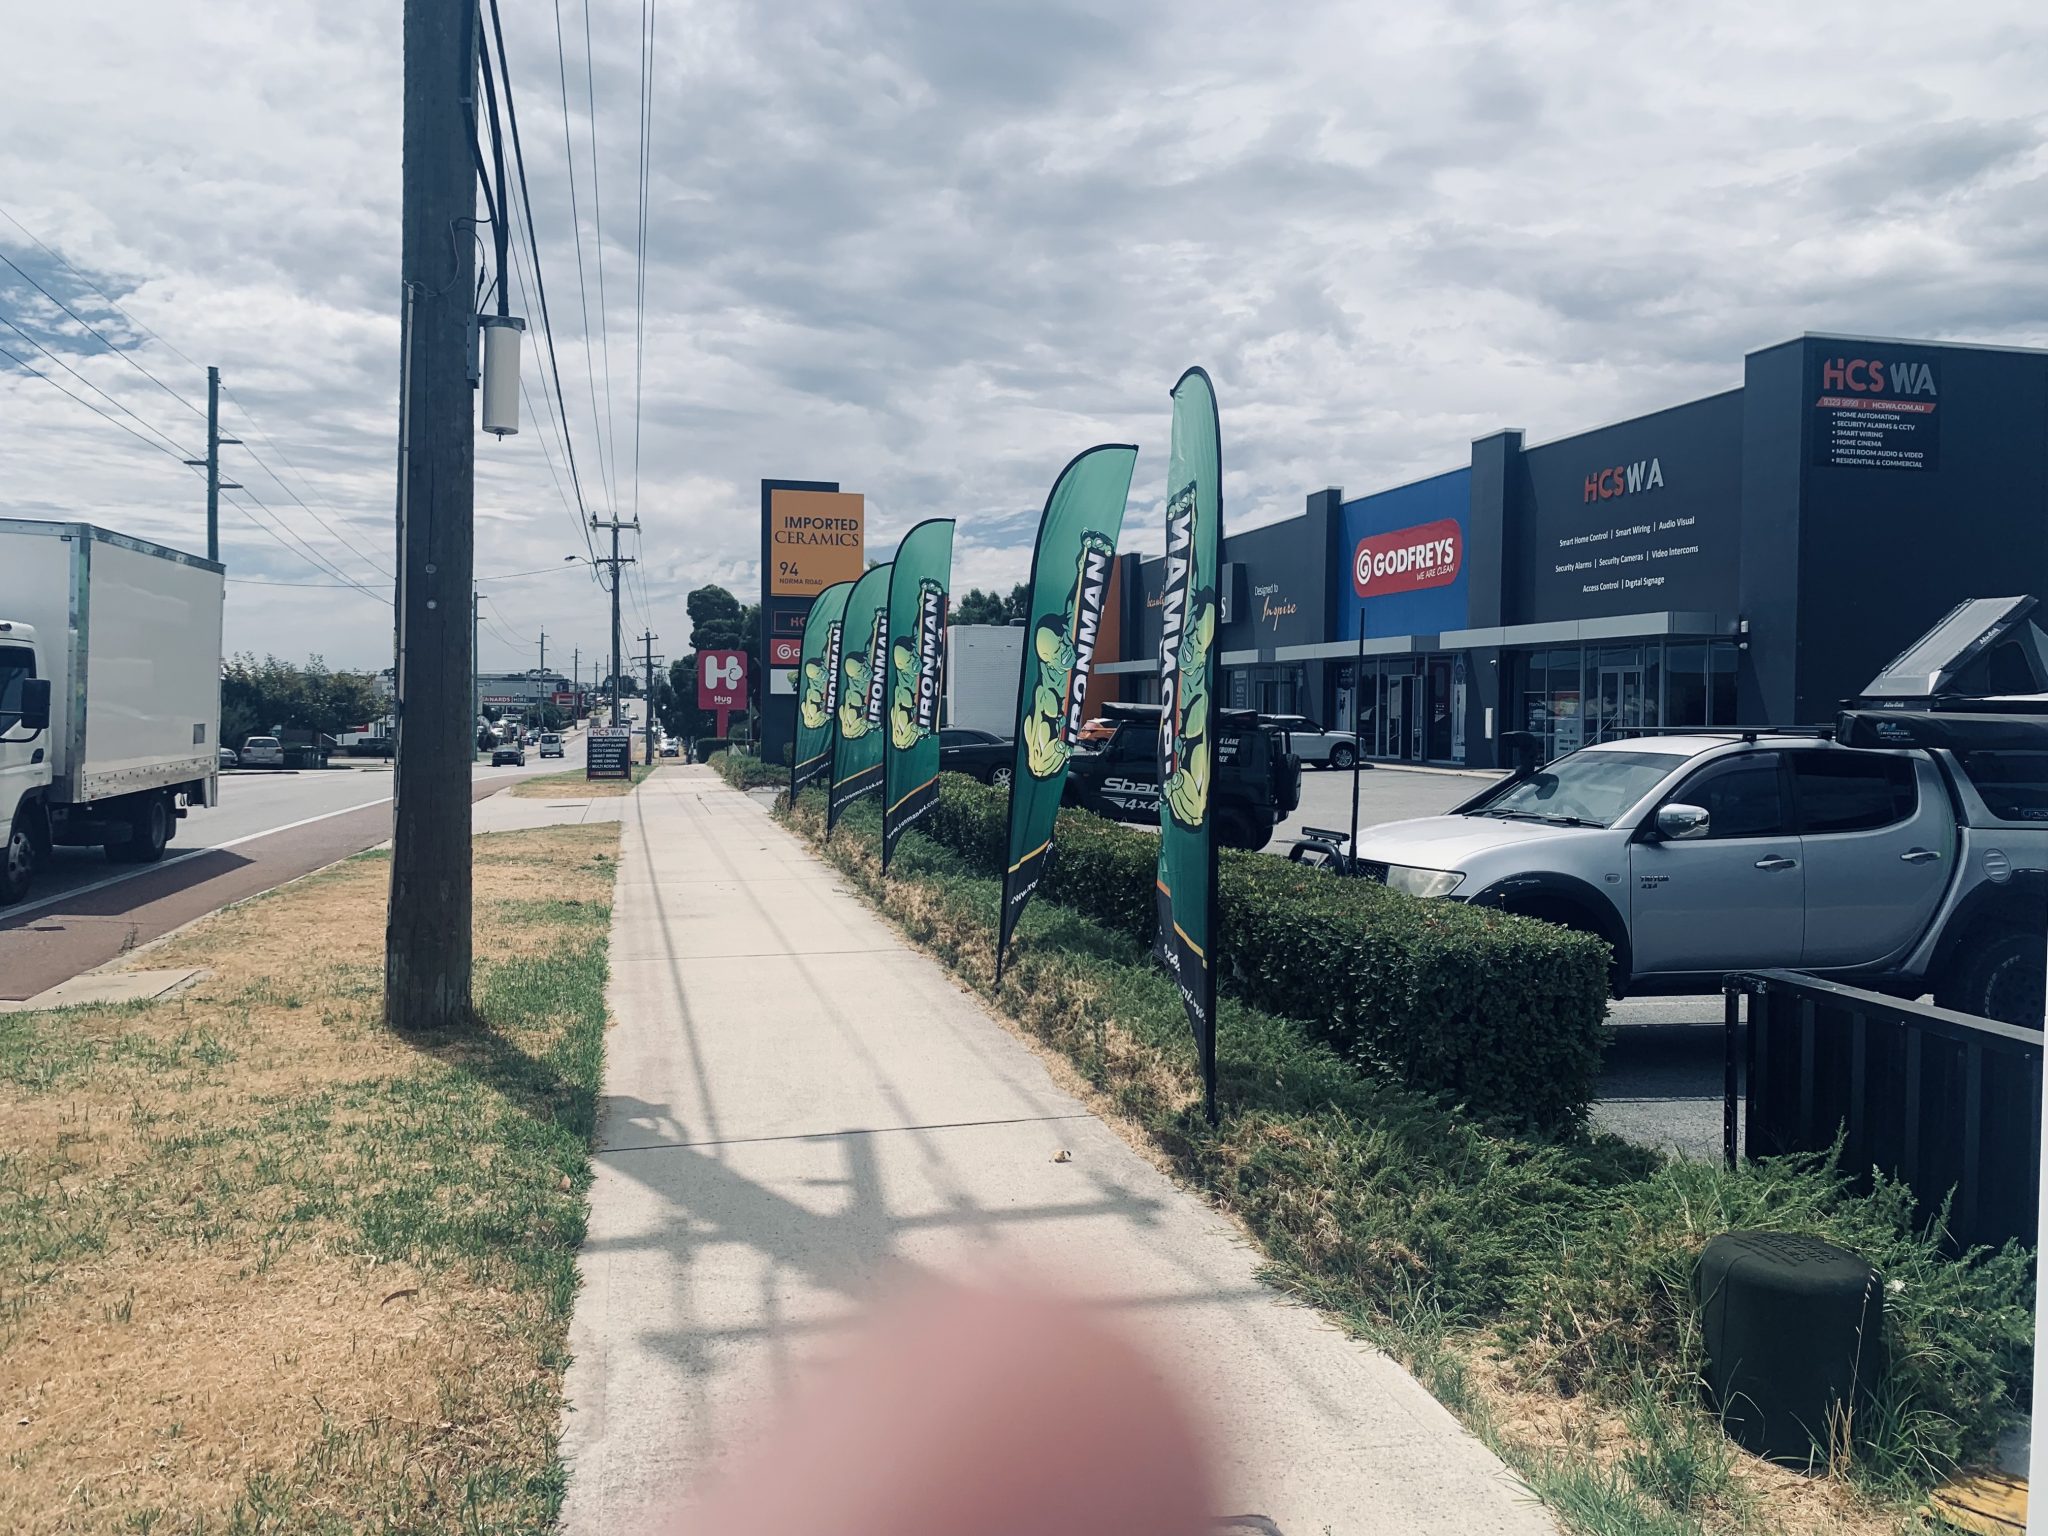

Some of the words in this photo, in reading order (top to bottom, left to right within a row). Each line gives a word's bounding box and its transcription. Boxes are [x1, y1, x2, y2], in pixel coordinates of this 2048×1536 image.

[1823, 358, 1885, 392] HCS
[1889, 362, 1937, 395] WA
[1857, 412, 1900, 420] AUTOMATION
[1836, 420, 1866, 428] SECURITY
[1867, 422, 1892, 430] ALARMS
[1860, 430, 1884, 438] WIRING
[1876, 450, 1897, 458] AUDIO
[1836, 458, 1875, 466] RESIDENTIAL
[1881, 459, 1922, 468] COMMERCIAL
[784, 516, 859, 531] IMPORTED
[1560, 538, 1574, 547] Smart
[1574, 535, 1589, 545] Home
[1589, 531, 1608, 542] Control
[1616, 528, 1631, 538] Smart
[1632, 524, 1650, 536] Wiring
[1658, 520, 1676, 530] Audio
[1676, 516, 1695, 527] Visual
[774, 530, 859, 547] CERAMICS
[1373, 537, 1454, 577] GODFREYS
[1555, 563, 1574, 573] Security
[1575, 560, 1592, 570] Alarms
[1599, 556, 1620, 567] Security
[1620, 553, 1644, 564] Cameras
[1651, 548, 1668, 559] Video
[1669, 544, 1699, 556] Intercoms
[780, 561, 799, 576] 94
[1416, 572, 1425, 581] WE
[1425, 568, 1436, 578] ARE
[1436, 564, 1455, 576] CLEAN
[1254, 584, 1273, 597] Designed
[1273, 583, 1279, 593] to
[1583, 584, 1599, 593] Access
[1600, 580, 1619, 591] Control
[1625, 577, 1642, 588] Digital
[1643, 575, 1665, 586] Signage
[1262, 597, 1297, 631] Inspire
[1068, 552, 1106, 744] IRONMAN
[919, 592, 938, 726] IRONMAN
[826, 628, 841, 714] IRONMAN
[868, 618, 888, 722] IRONMAN
[714, 696, 732, 705] Hug
[1124, 798, 1160, 812] 4x4
